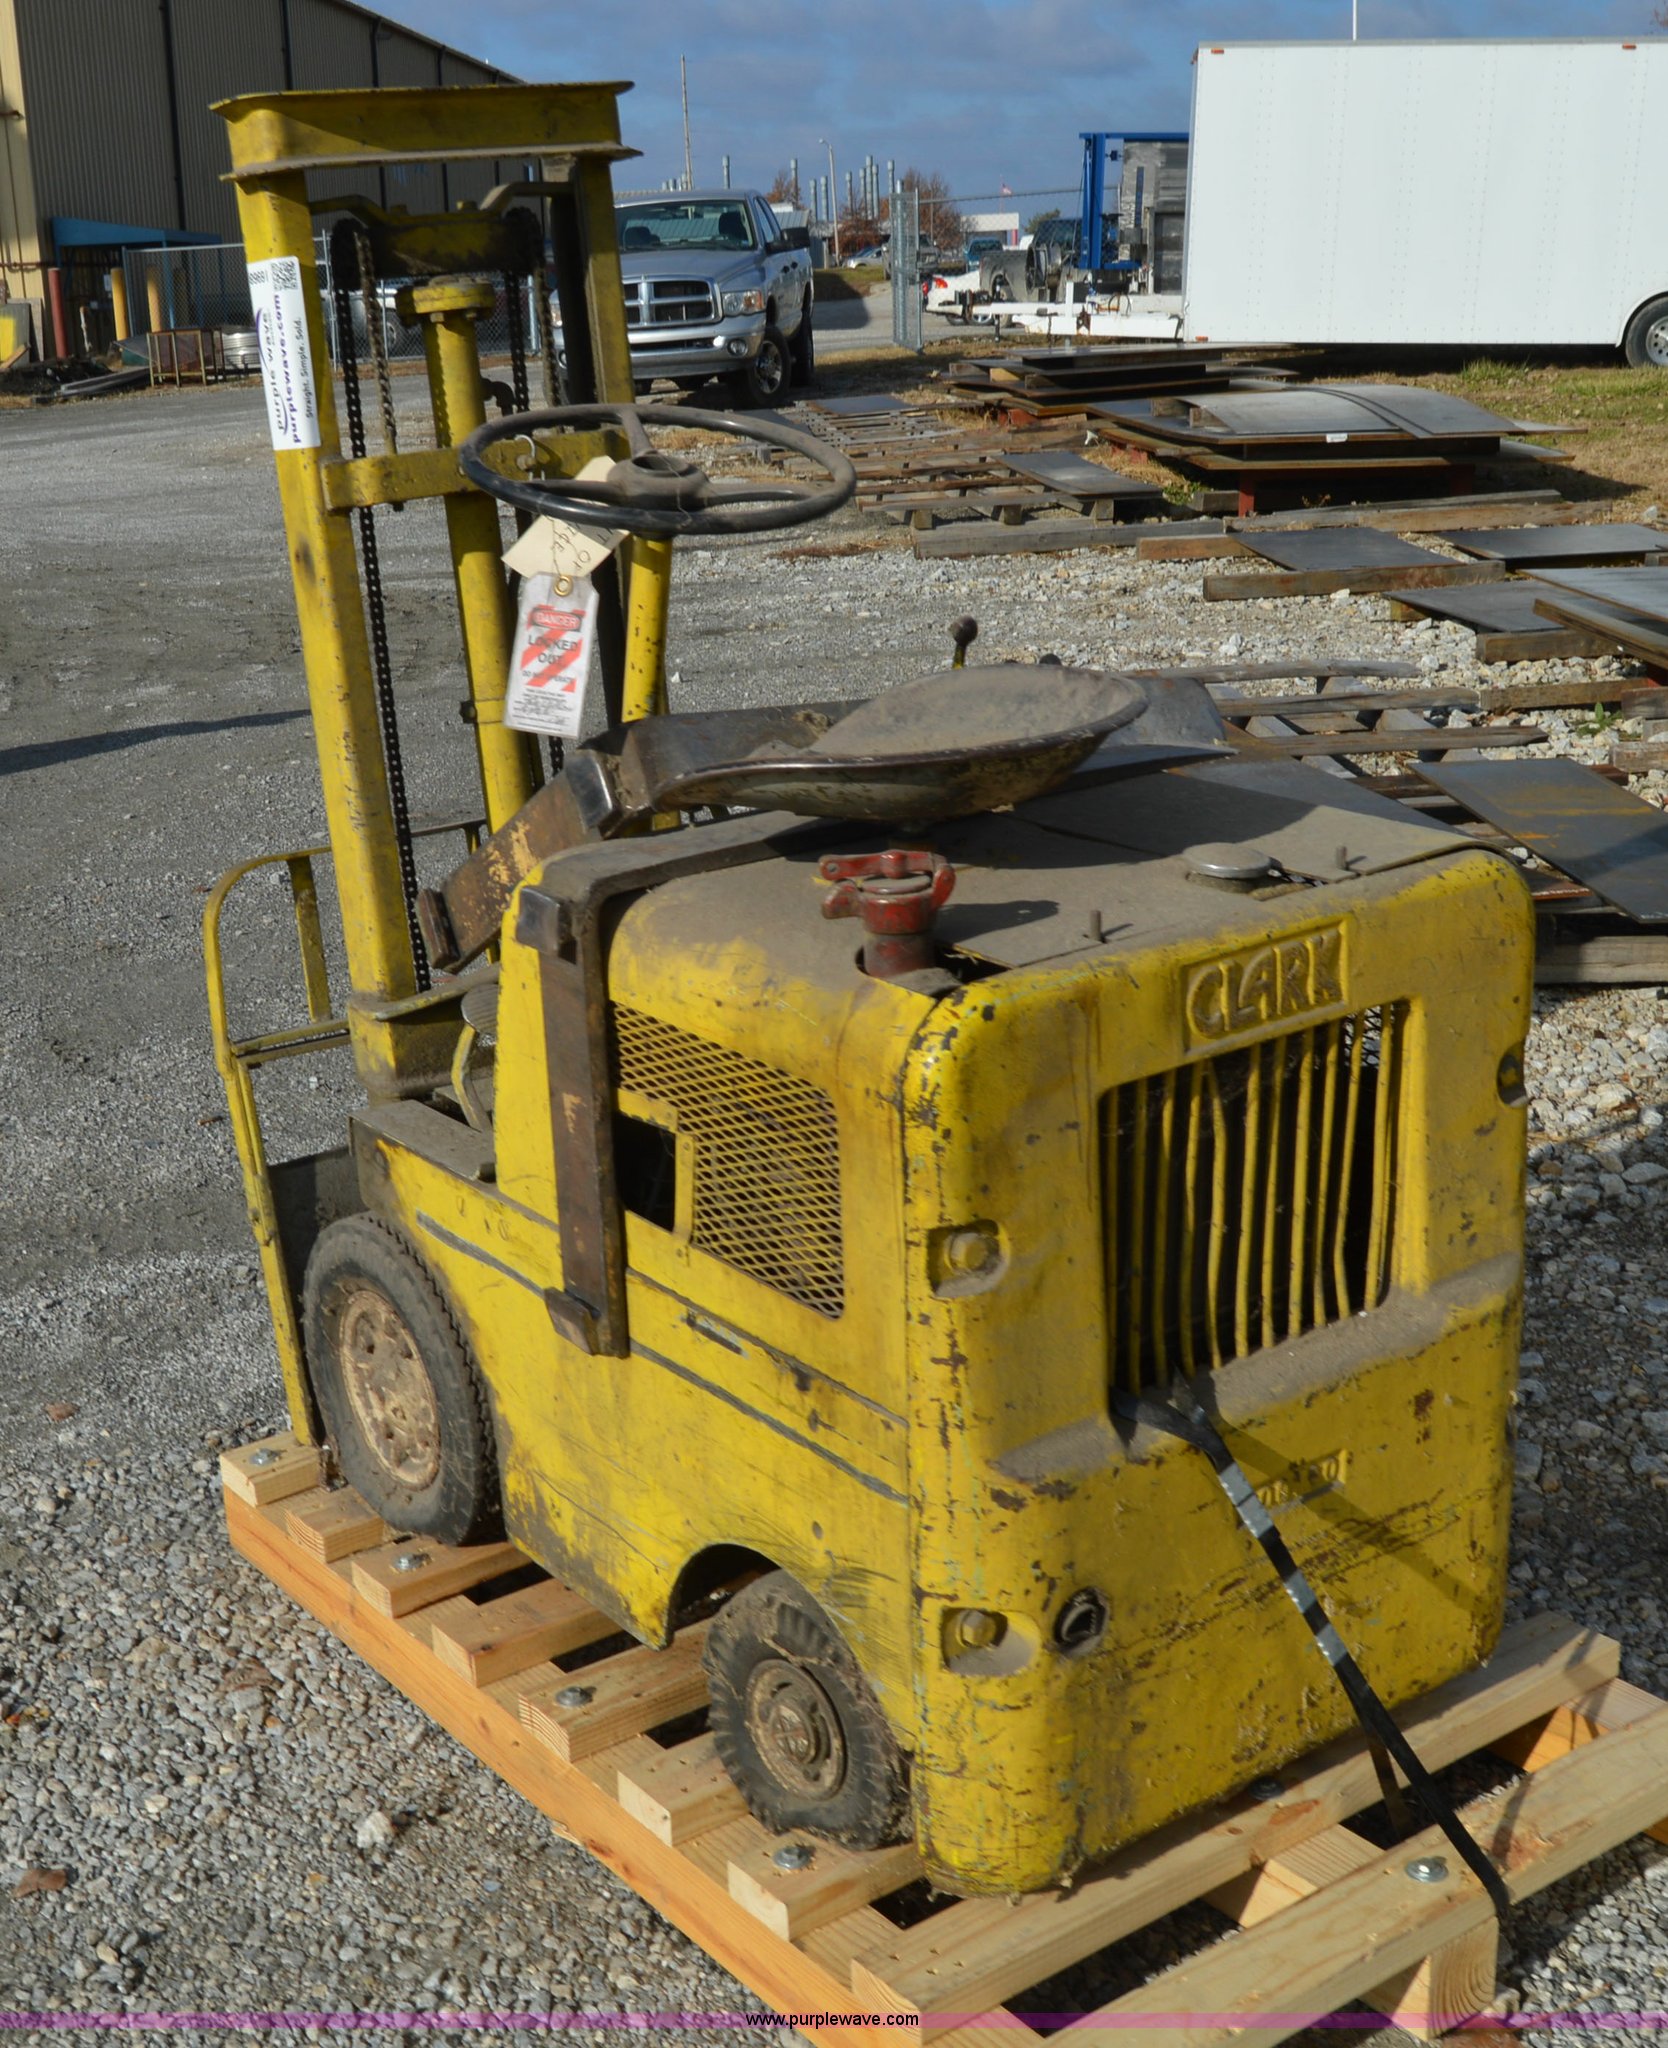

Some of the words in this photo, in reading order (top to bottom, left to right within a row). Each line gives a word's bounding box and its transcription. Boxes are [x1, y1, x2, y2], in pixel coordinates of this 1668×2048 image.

[262, 312, 274, 363] wave
[292, 316, 305, 341] Sold.
[273, 293, 302, 444] purplewave.com
[297, 343, 309, 377] Simple.
[268, 369, 285, 430] purple
[302, 380, 314, 419] Straight.
[536, 611, 578, 628] DANGER
[527, 634, 579, 652] LOCKED
[537, 652, 566, 666] OUT
[1186, 926, 1342, 1040] CLARK
